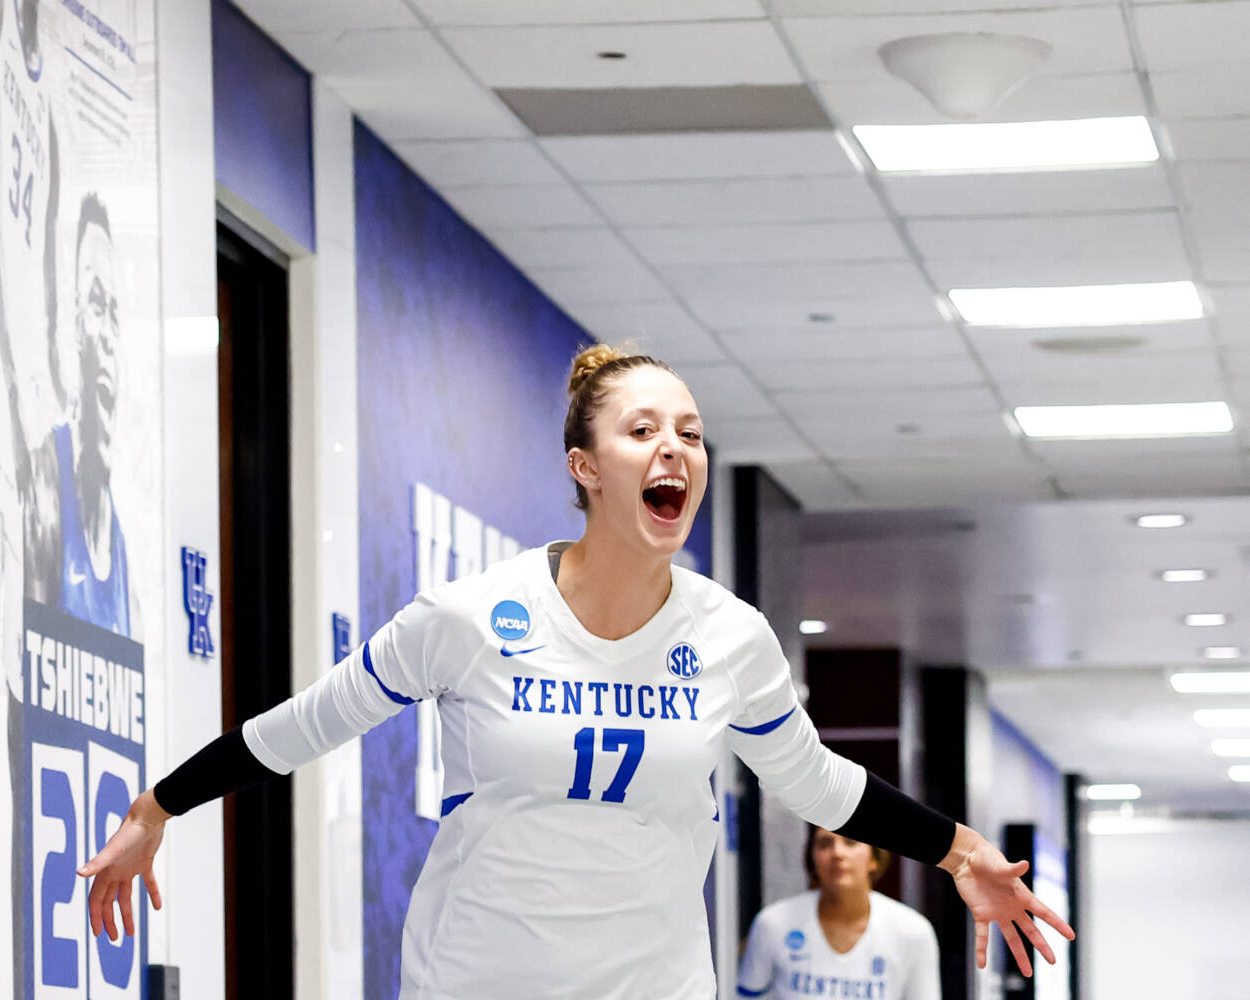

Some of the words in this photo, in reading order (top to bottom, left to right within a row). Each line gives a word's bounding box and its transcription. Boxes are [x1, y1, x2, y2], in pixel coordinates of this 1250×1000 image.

[495, 616, 528, 632] NCAA
[670, 645, 699, 677] SEC
[26, 629, 144, 745] TSHIEBWE
[511, 676, 700, 721] KENTUCKY
[567, 727, 645, 803] 17
